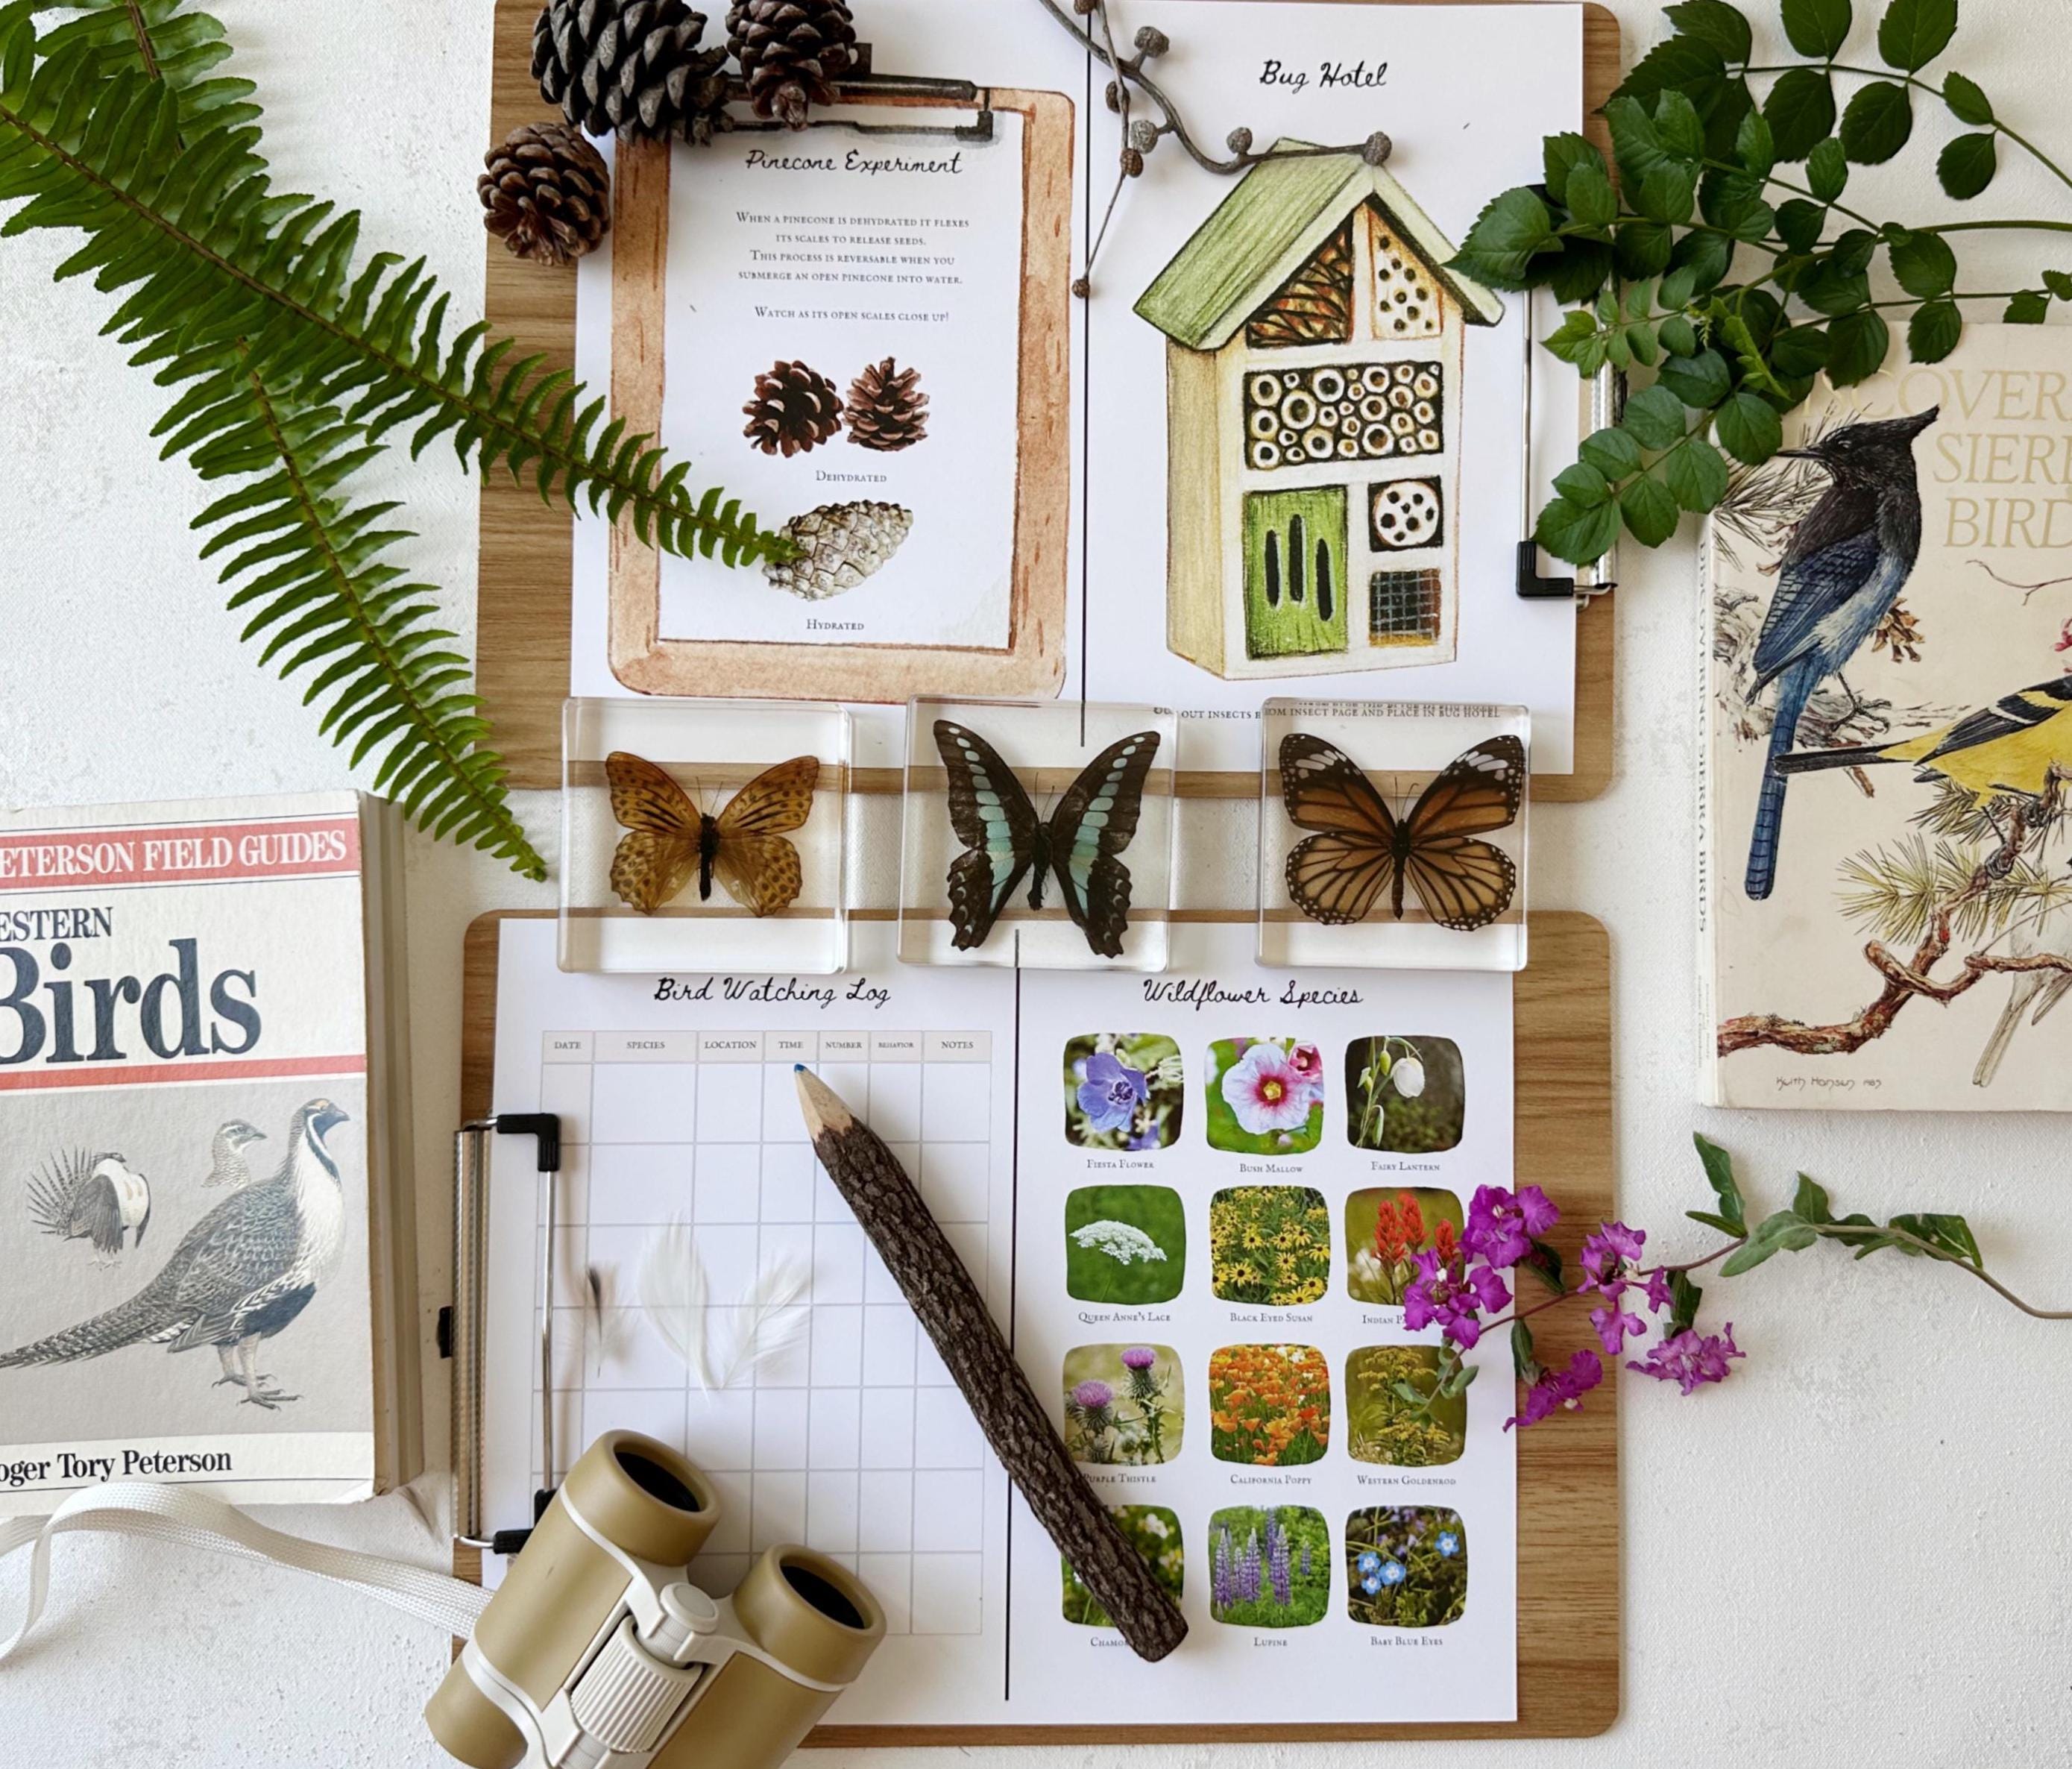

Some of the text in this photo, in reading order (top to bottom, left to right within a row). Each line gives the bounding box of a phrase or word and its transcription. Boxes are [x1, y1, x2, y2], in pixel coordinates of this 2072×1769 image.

[1259, 60, 1388, 93] Bug Hotel
[745, 148, 962, 175] Pinecone Experiment
[1943, 497, 2072, 549] BIRD
[1209, 711, 1251, 719] INSECTS
[0, 830, 346, 878] ETERSON FIELD GUIDES
[0, 906, 113, 942] ESTERN
[0, 937, 262, 1064] Birds
[654, 976, 890, 1009] Bird Watching Log
[1144, 979, 1363, 1011] Wildflower Species
[0, 1450, 232, 1486] oger Tory Peterson
